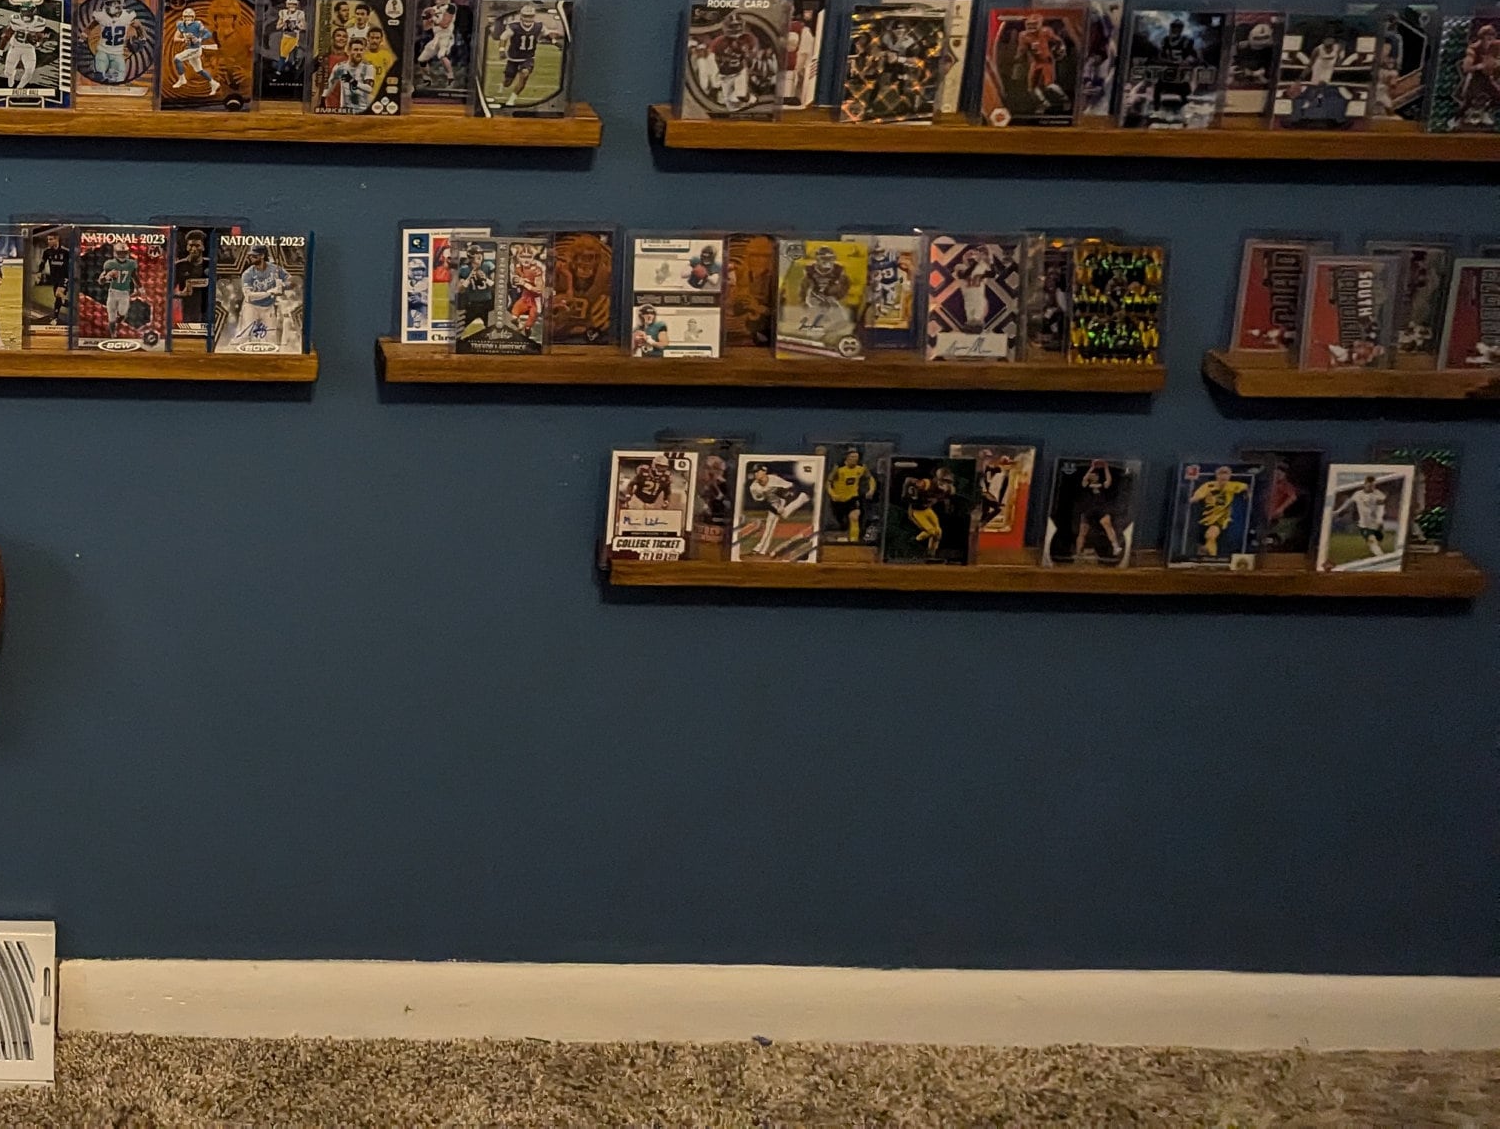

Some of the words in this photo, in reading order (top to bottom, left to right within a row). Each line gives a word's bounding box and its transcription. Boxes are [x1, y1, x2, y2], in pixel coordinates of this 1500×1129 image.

[707, 0, 740, 9] ROOKIE
[744, 0, 770, 9] CARD
[101, 26, 126, 46] 42
[519, 35, 535, 50] 11
[81, 232, 136, 244] NATIONAL
[139, 233, 166, 244] 2023
[220, 235, 277, 246] NATIONAL
[280, 236, 305, 247] 2023
[1357, 270, 1373, 317] SOUTH
[616, 539, 650, 549] COLLEGE
[652, 539, 682, 549] TICKET
